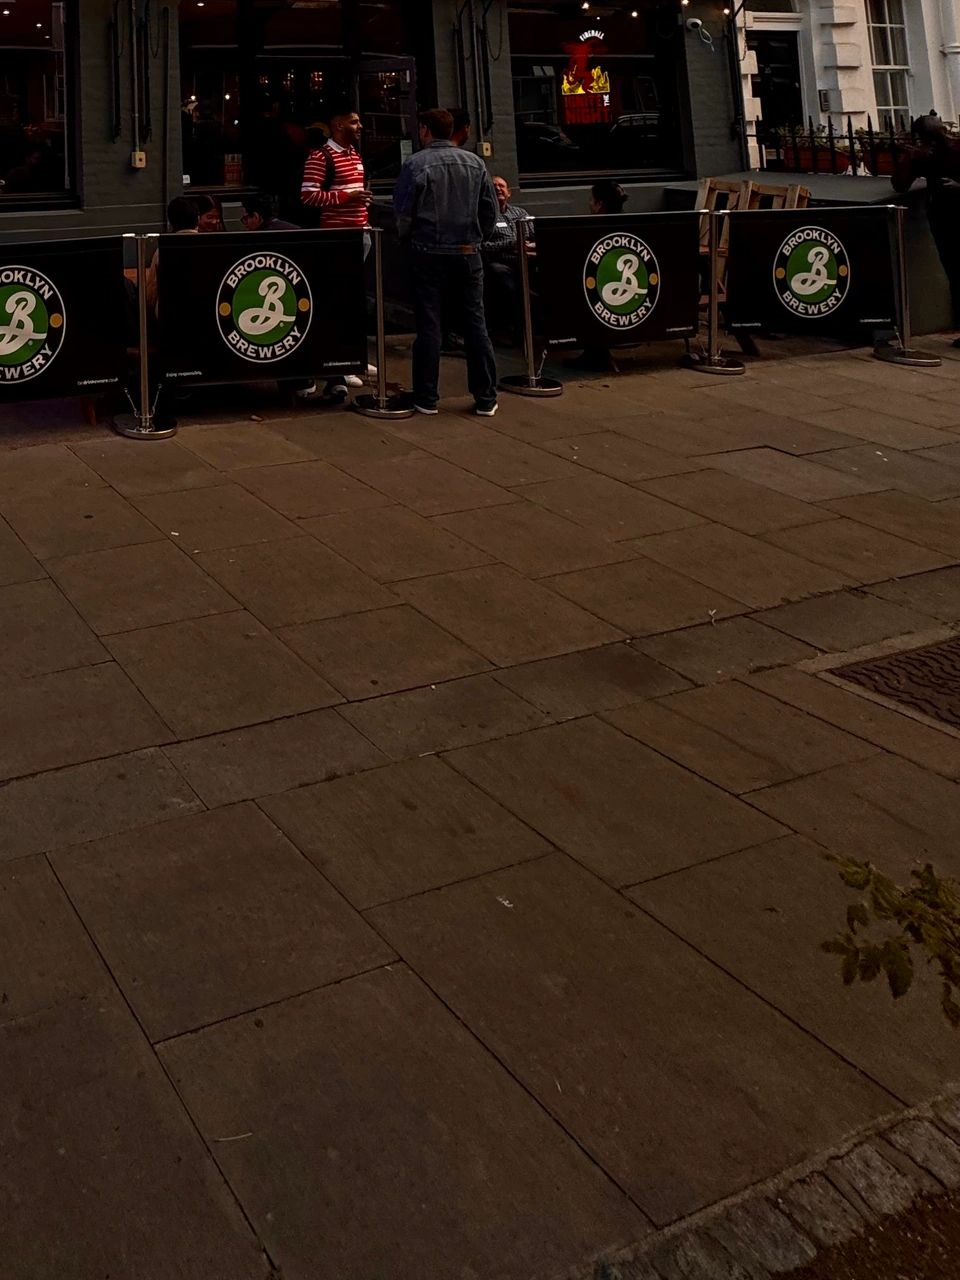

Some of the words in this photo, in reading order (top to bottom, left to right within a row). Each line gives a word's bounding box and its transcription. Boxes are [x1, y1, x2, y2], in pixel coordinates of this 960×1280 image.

[590, 236, 650, 265] BROOKLYN
[782, 229, 840, 257] BROOKLYN
[226, 256, 301, 288] BROOKLYN
[594, 297, 653, 326] BREWERY
[782, 287, 842, 315] BREWERY
[227, 325, 302, 358] BREWERY
